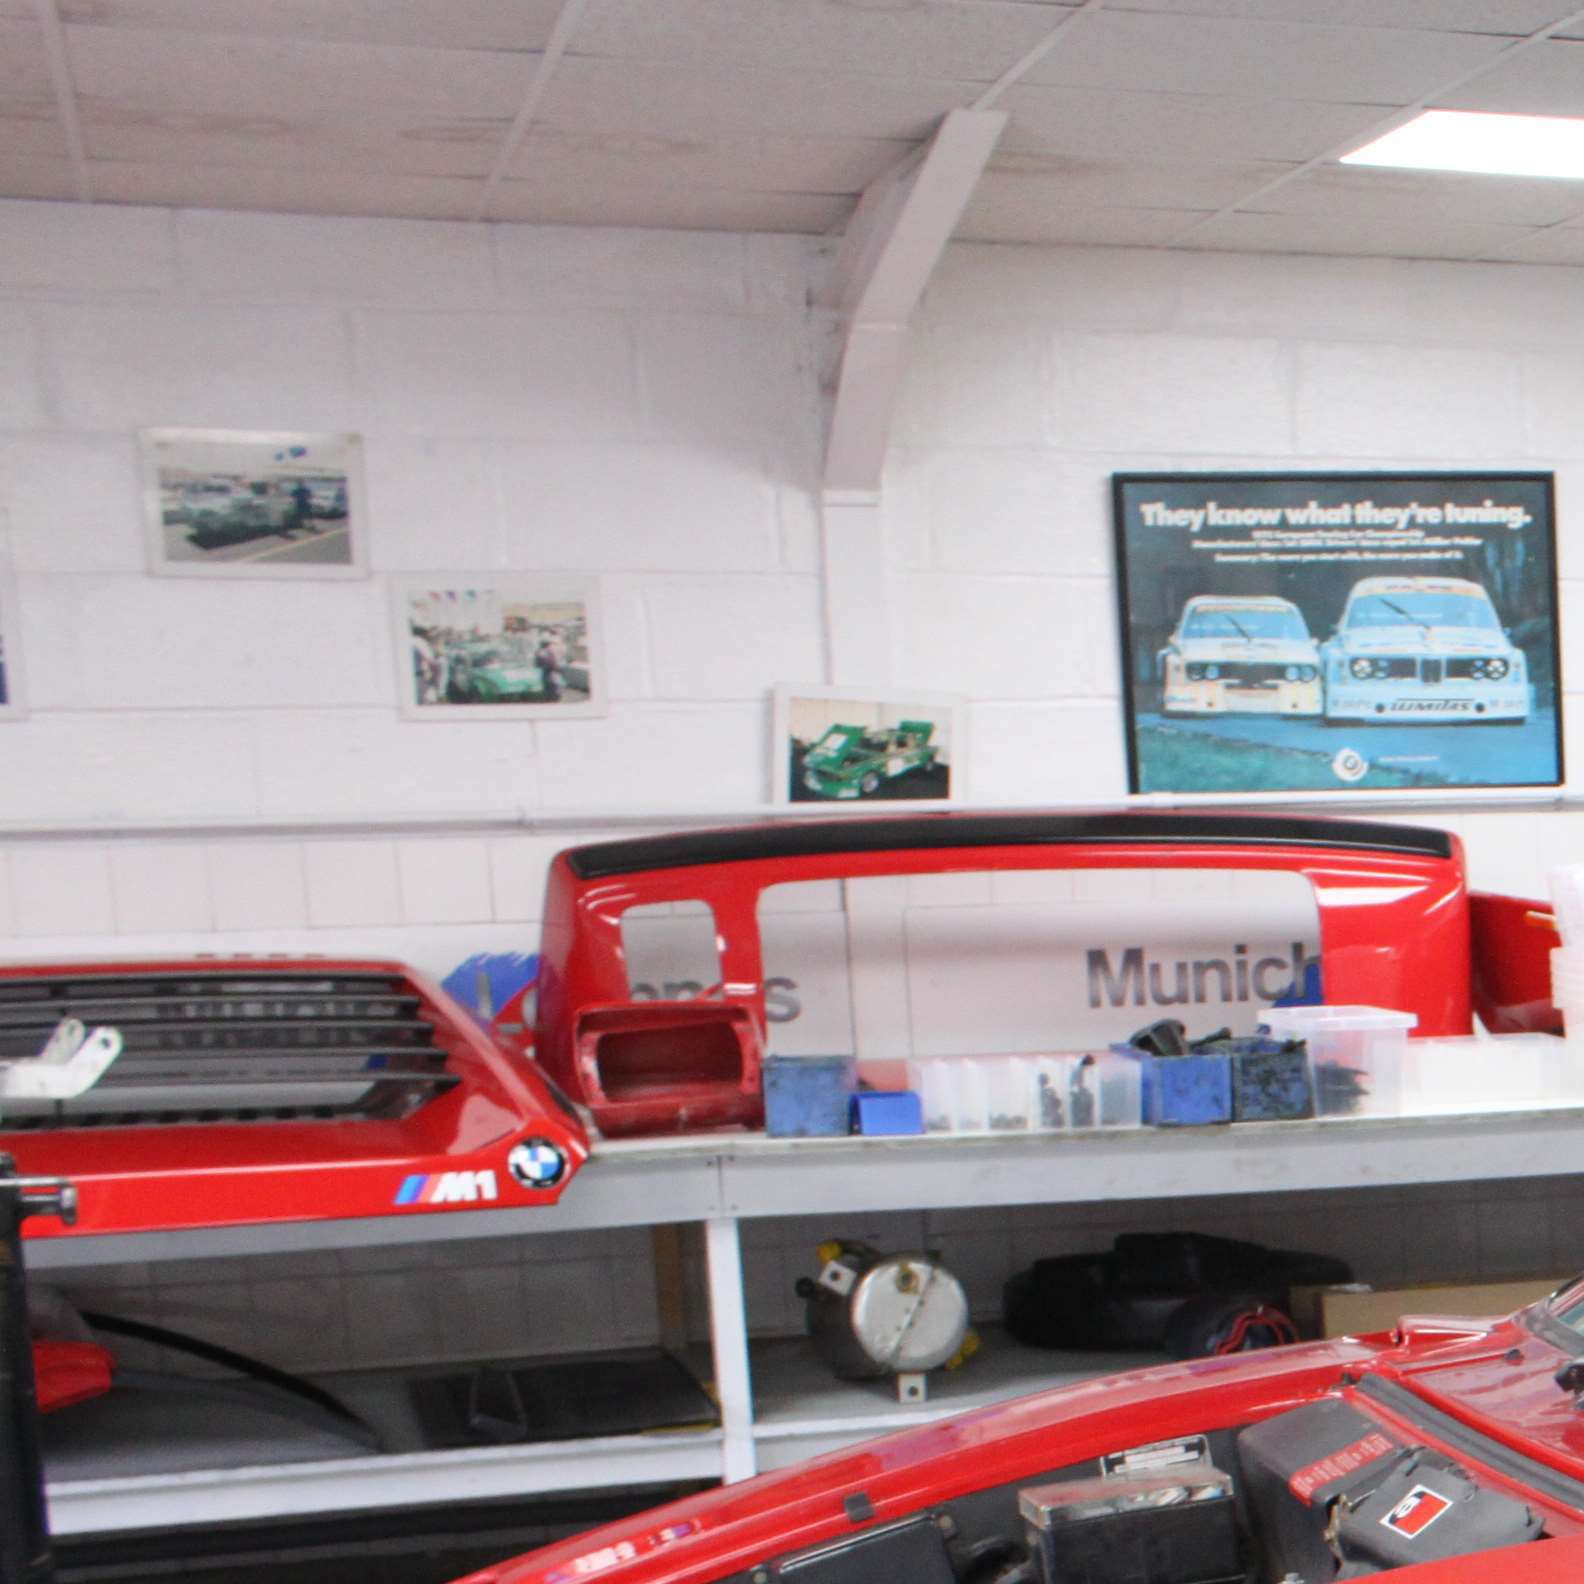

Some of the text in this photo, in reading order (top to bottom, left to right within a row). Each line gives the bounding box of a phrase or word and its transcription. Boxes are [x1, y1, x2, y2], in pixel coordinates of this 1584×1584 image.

[1139, 499, 1533, 533] They know what they're tuning.
[428, 1168, 499, 1204] M1
